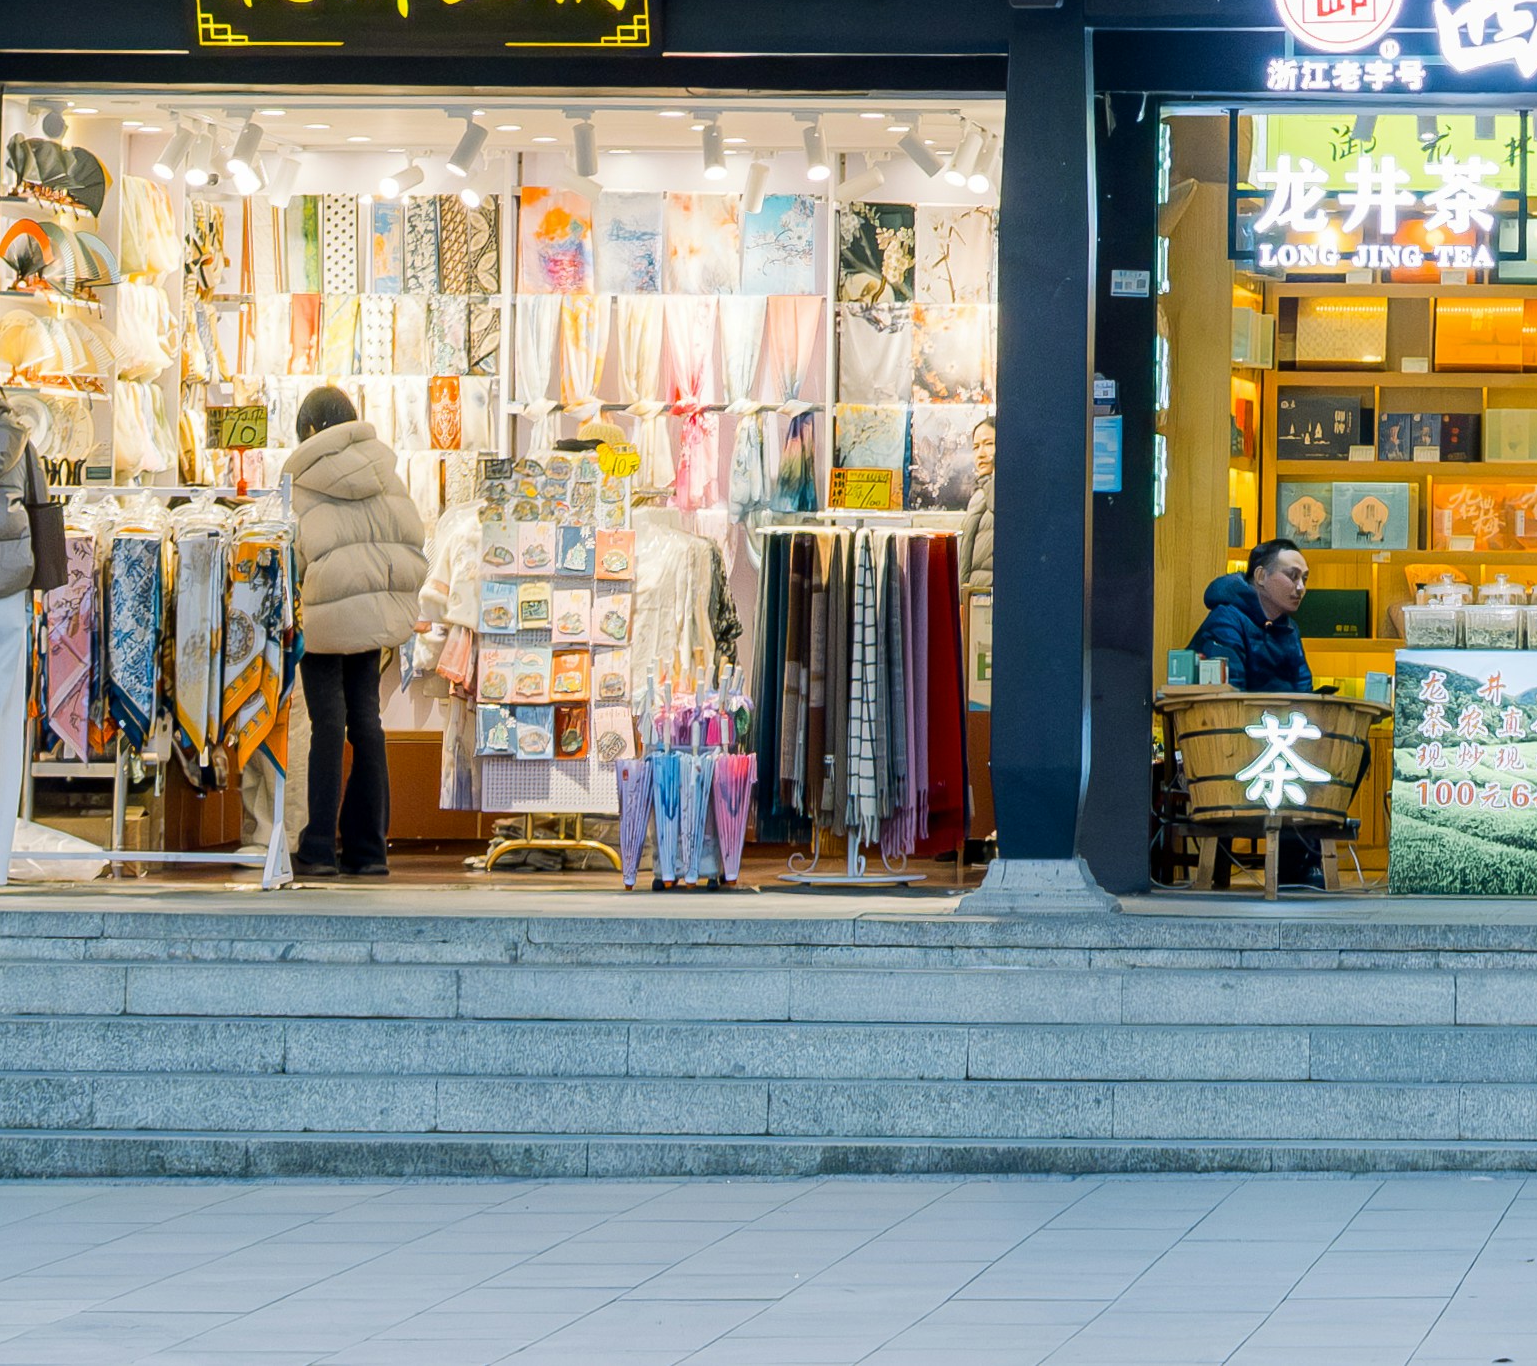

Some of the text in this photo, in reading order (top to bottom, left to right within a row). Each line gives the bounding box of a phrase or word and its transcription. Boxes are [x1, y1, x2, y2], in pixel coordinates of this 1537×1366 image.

[1266, 58, 1427, 92] 浙江老字号
[1253, 153, 1501, 234] 龙井茶
[1259, 243, 1496, 268] LONG JING TEA
[1235, 709, 1333, 810] 茶
